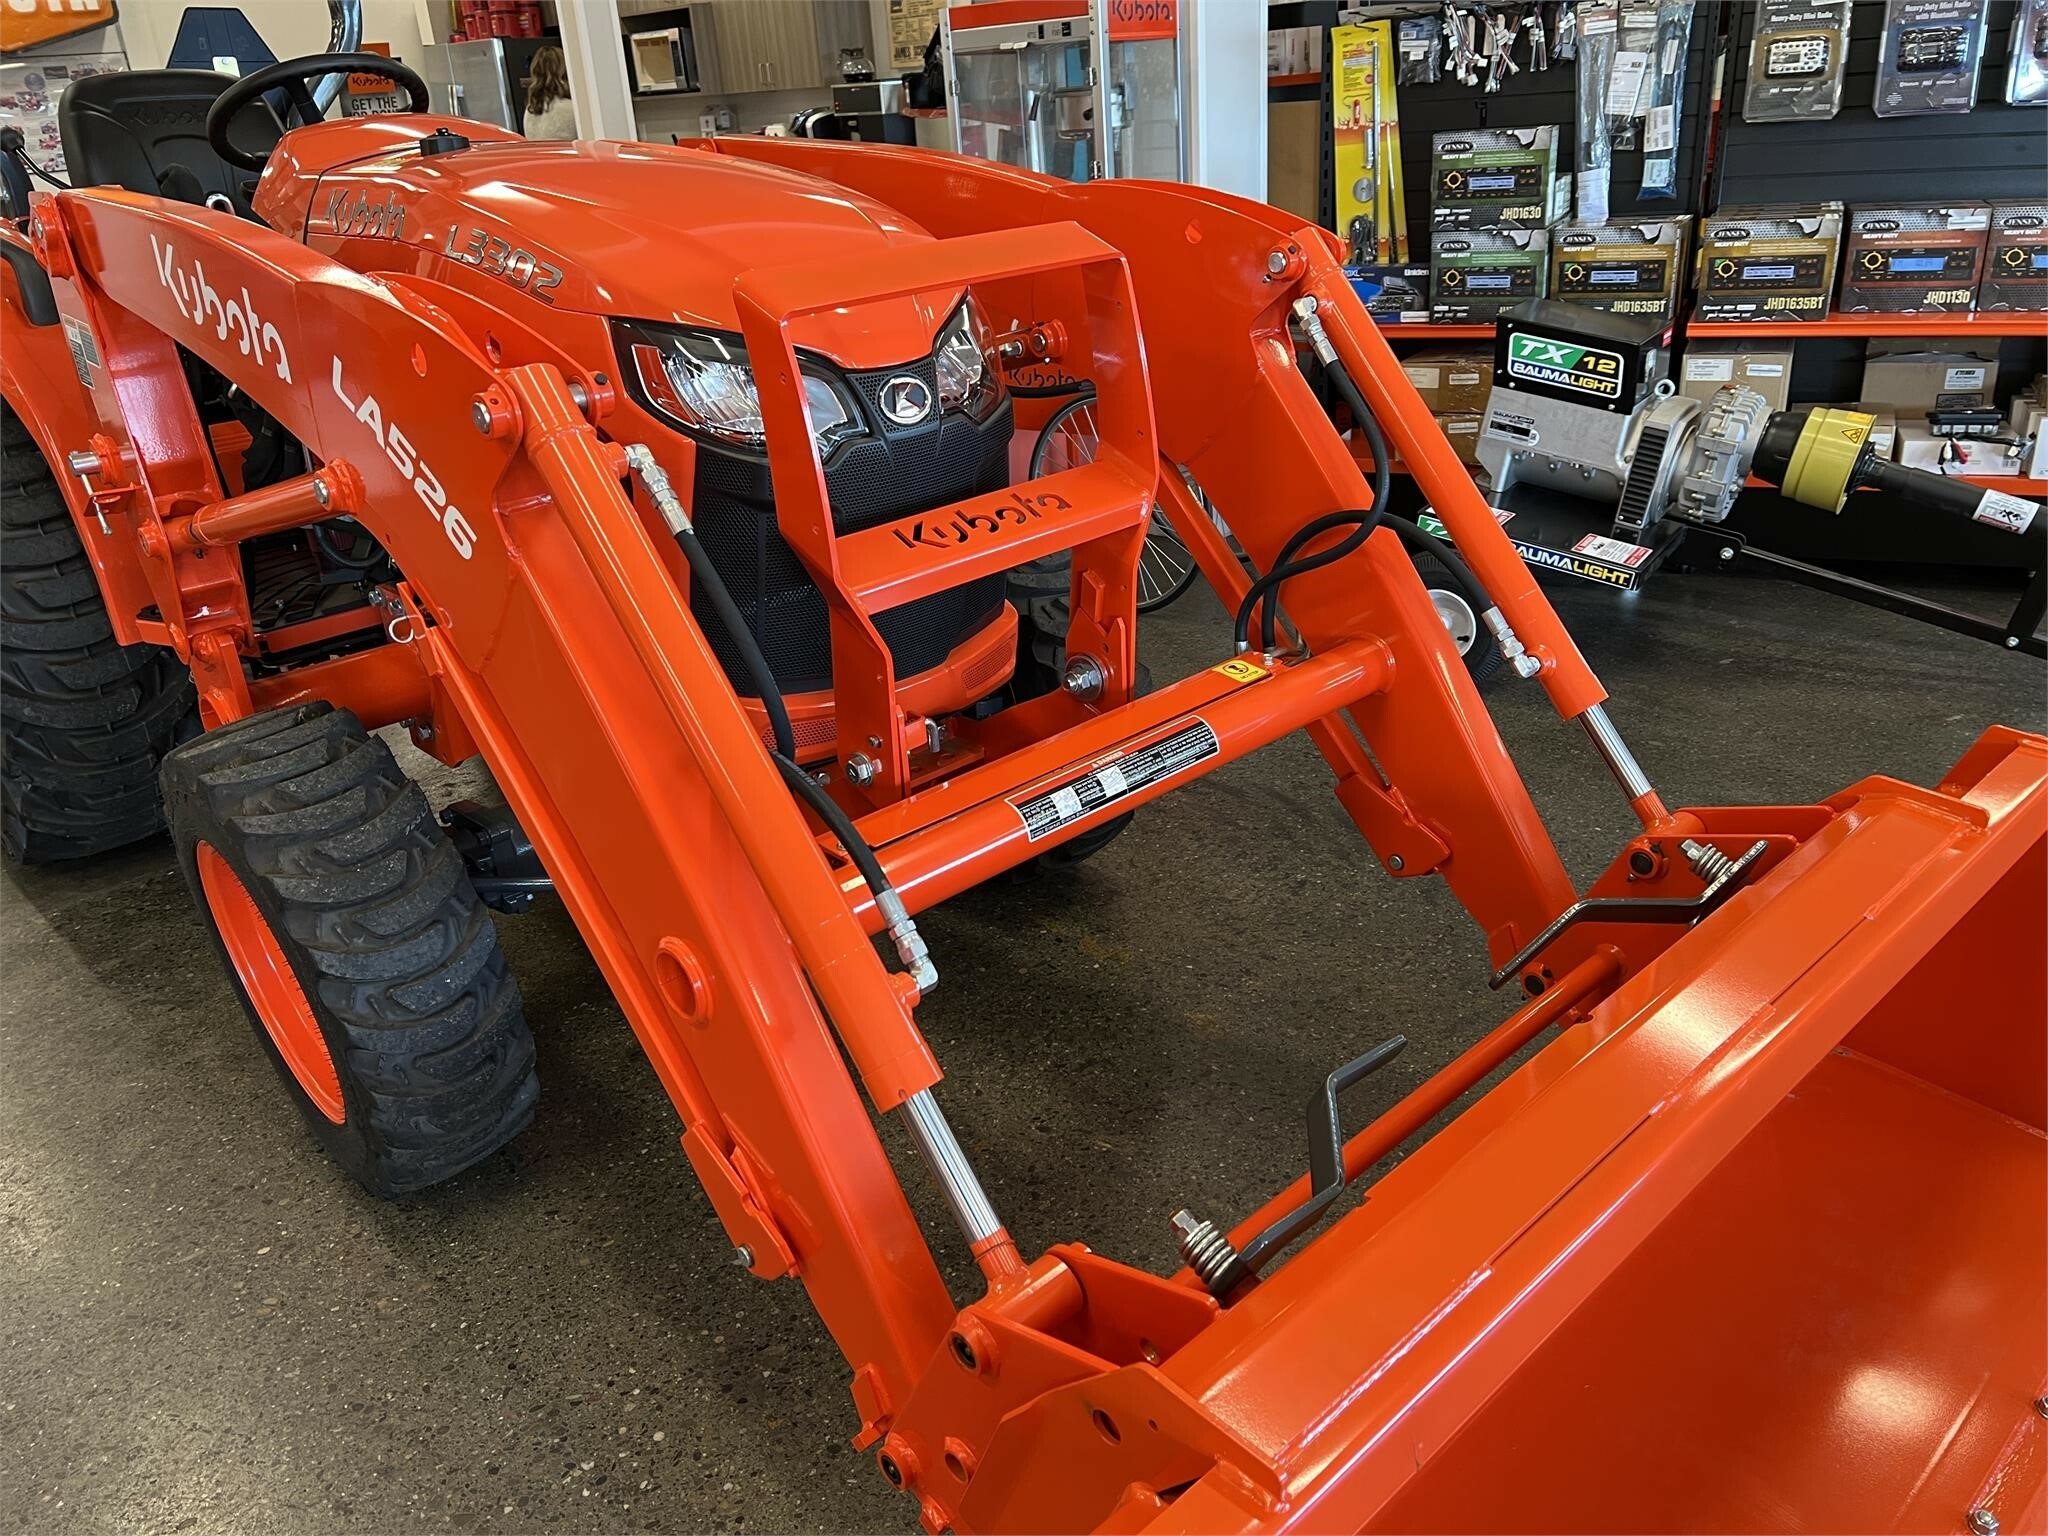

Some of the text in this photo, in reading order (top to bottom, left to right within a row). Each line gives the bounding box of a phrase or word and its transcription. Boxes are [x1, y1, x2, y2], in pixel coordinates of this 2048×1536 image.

[1112, 0, 1171, 21] Kubota
[351, 96, 398, 110] GET THE
[325, 188, 405, 239] Kubota
[1500, 207, 1542, 219] JHD1630
[444, 224, 563, 305] L3302
[151, 233, 293, 385] Kubota
[1610, 300, 1667, 313] JHD1635BT
[1763, 296, 1825, 310] JHD1635BT
[1923, 290, 1971, 304] JHD1130
[1520, 339, 1617, 374] TX 12
[1009, 367, 1075, 387] Kubota
[1512, 362, 1616, 393] BAUMALIGHT
[333, 355, 478, 560] LA526
[892, 493, 1072, 548] Kubota
